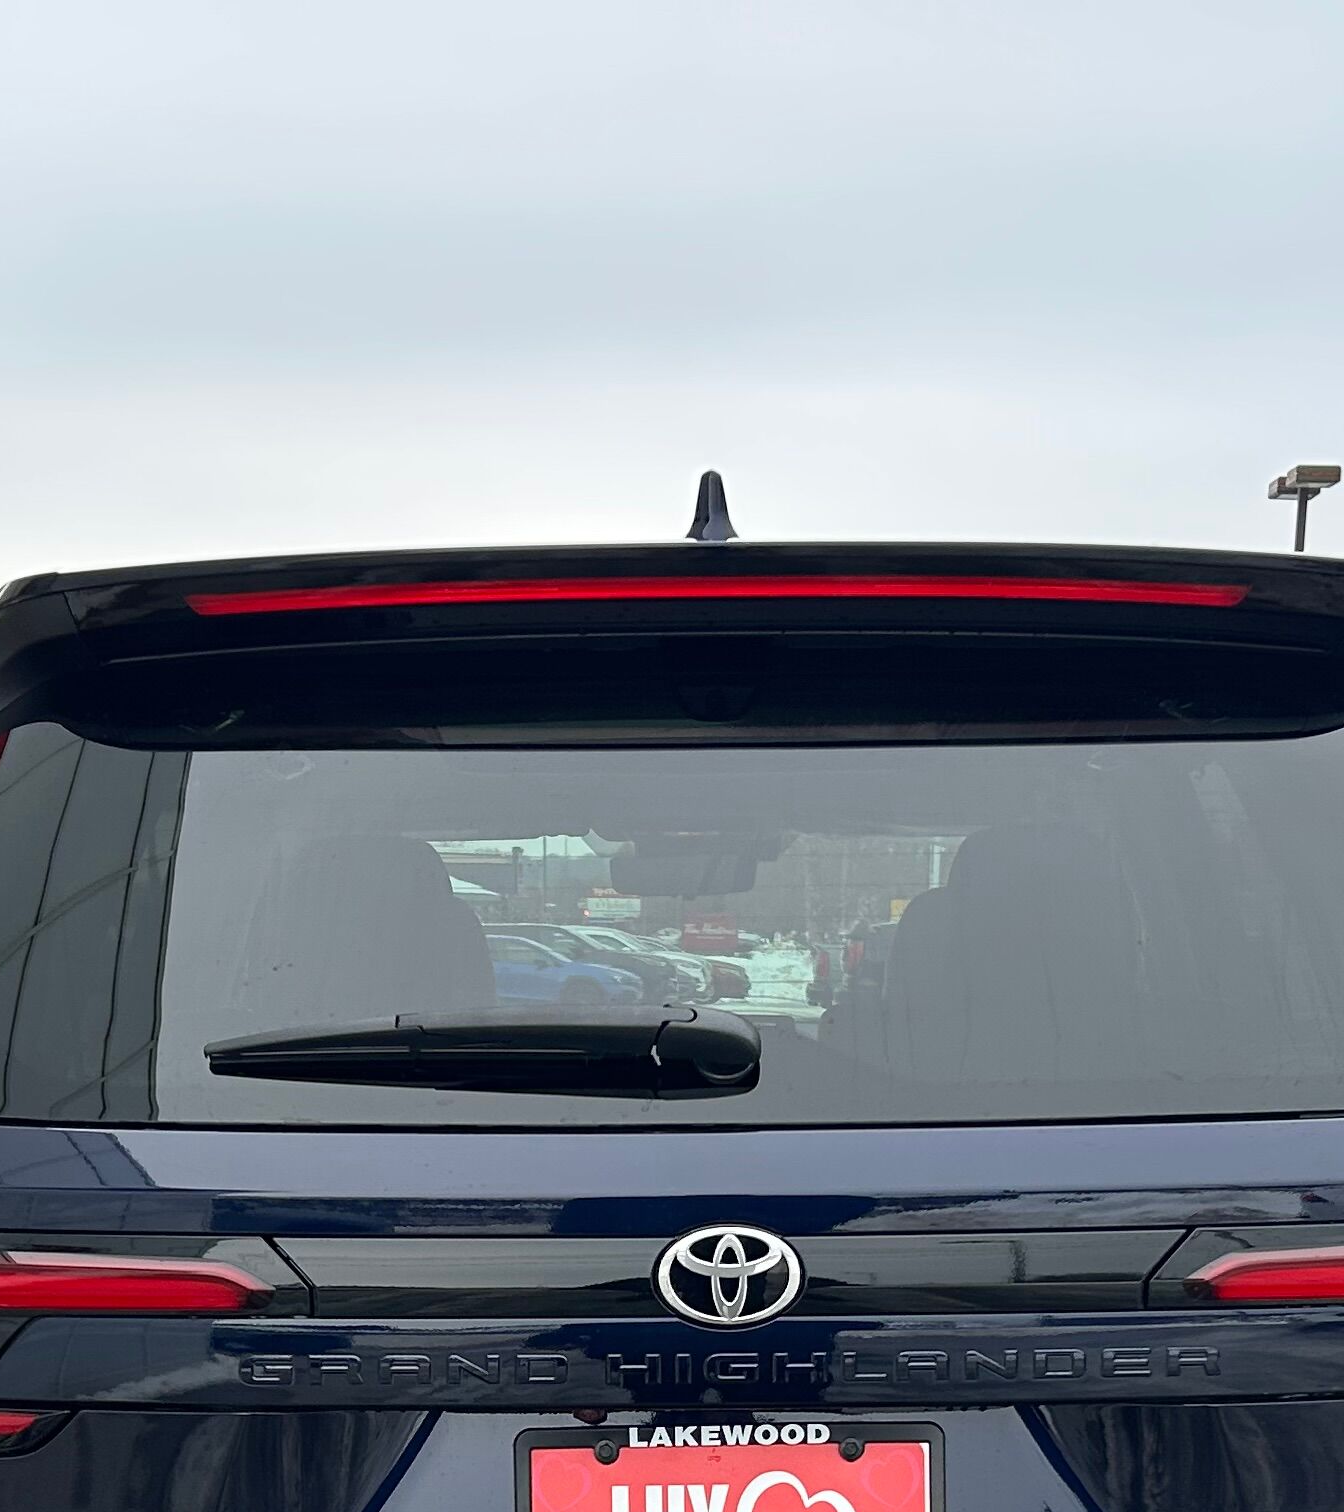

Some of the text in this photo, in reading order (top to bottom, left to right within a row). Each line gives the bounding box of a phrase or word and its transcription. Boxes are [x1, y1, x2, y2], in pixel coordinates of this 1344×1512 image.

[240, 1346, 1223, 1388] GRAND HIGHLANDER
[629, 1423, 831, 1448] LAKEWOOD
